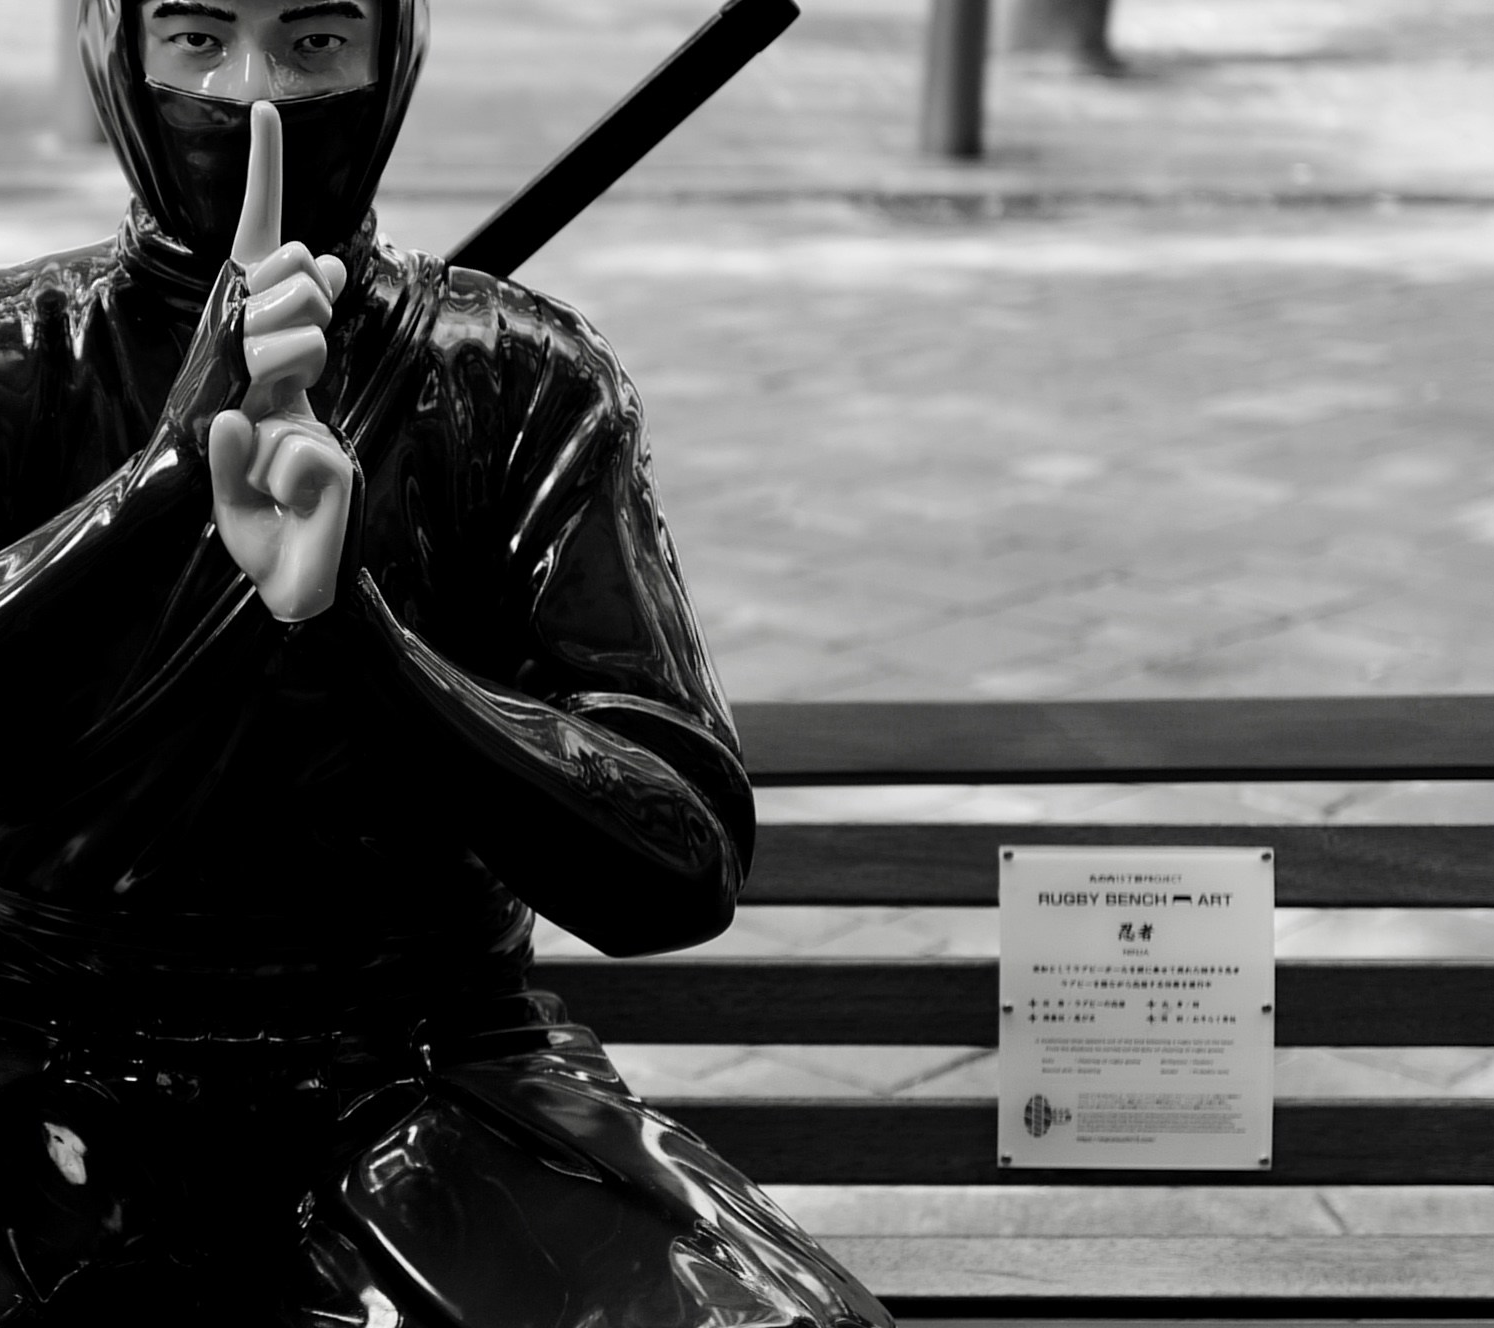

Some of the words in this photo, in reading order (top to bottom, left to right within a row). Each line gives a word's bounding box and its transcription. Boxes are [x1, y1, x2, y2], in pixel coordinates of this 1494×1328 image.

[1038, 891, 1099, 907] RUGBY
[1106, 892, 1167, 907] BENCH
[1197, 892, 1233, 907] ART
